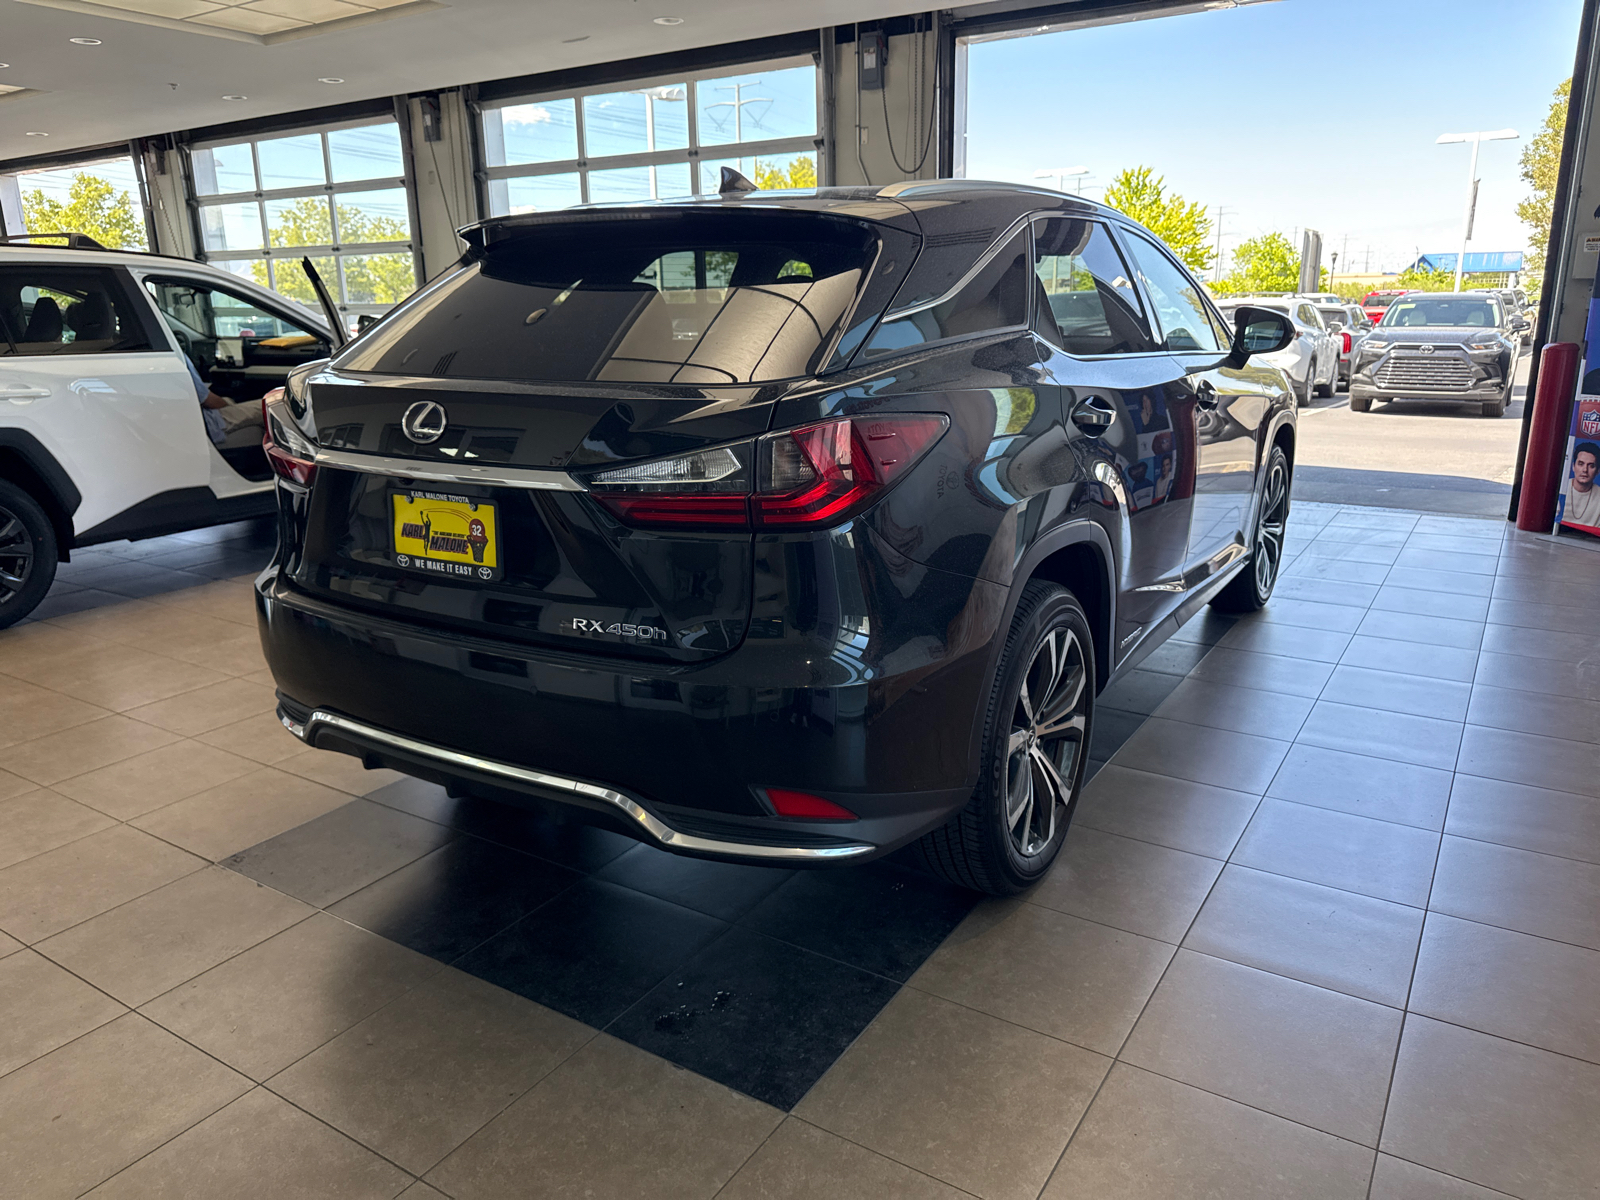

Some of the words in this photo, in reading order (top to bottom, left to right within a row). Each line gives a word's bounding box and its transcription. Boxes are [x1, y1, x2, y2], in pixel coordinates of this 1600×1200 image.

[1583, 421, 1600, 434] NFL
[410, 490, 425, 499] KARL
[425, 492, 448, 502] MALONE
[448, 495, 470, 504] TOYOTA
[401, 522, 425, 539] KARL
[471, 524, 482, 537] 32
[429, 536, 469, 555] MALONE
[414, 558, 425, 568] WE
[426, 560, 445, 572] MAKE
[446, 563, 453, 573] IT
[455, 564, 473, 576] EASY
